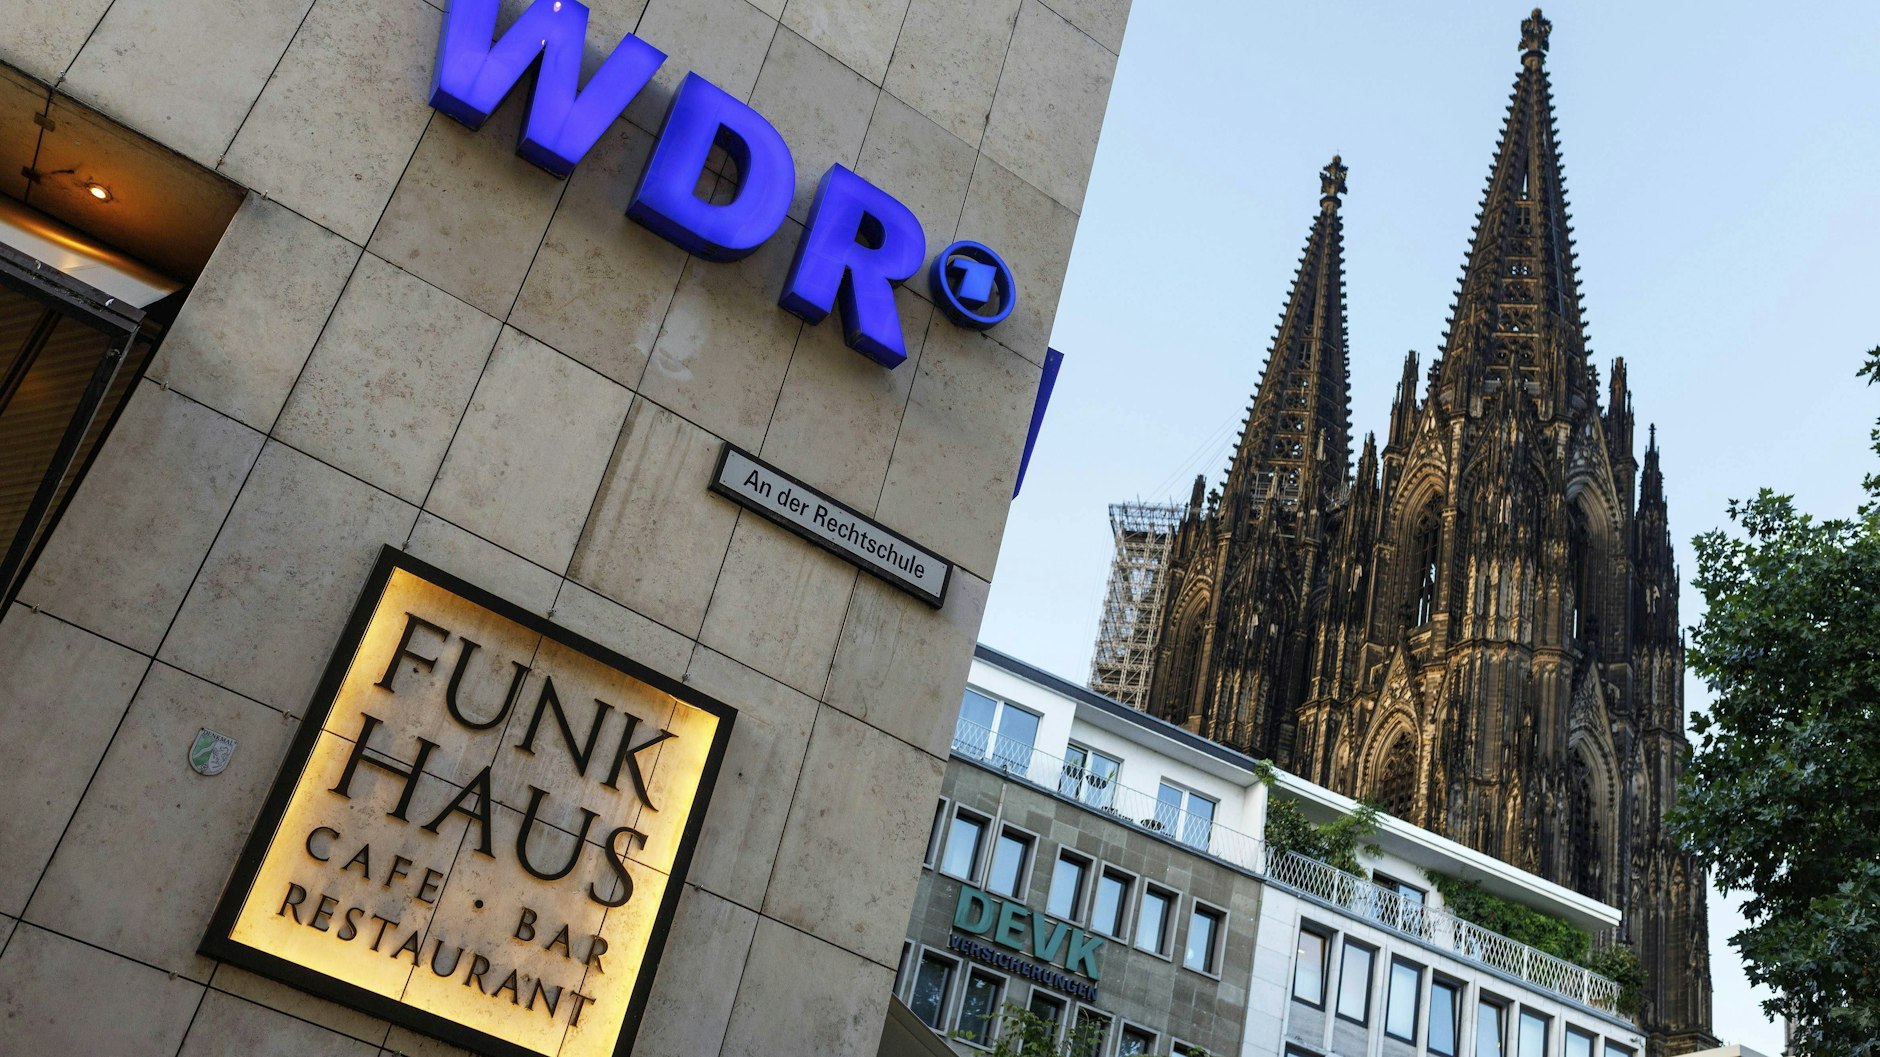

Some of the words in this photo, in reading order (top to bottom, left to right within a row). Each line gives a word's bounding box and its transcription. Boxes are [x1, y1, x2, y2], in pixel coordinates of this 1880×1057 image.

[429, 0, 926, 370] WDR
[743, 469, 772, 498] An
[777, 488, 810, 517] der
[812, 504, 926, 579] Rechtschule
[373, 611, 679, 812] FUNK
[328, 712, 649, 908] HAUS
[277, 882, 597, 1029] RESTAURANT
[305, 826, 444, 904] CAFE
[512, 906, 609, 974] BAR
[949, 934, 1099, 1001] VERSICHERUNGEN
[953, 885, 1104, 980] DEVK
